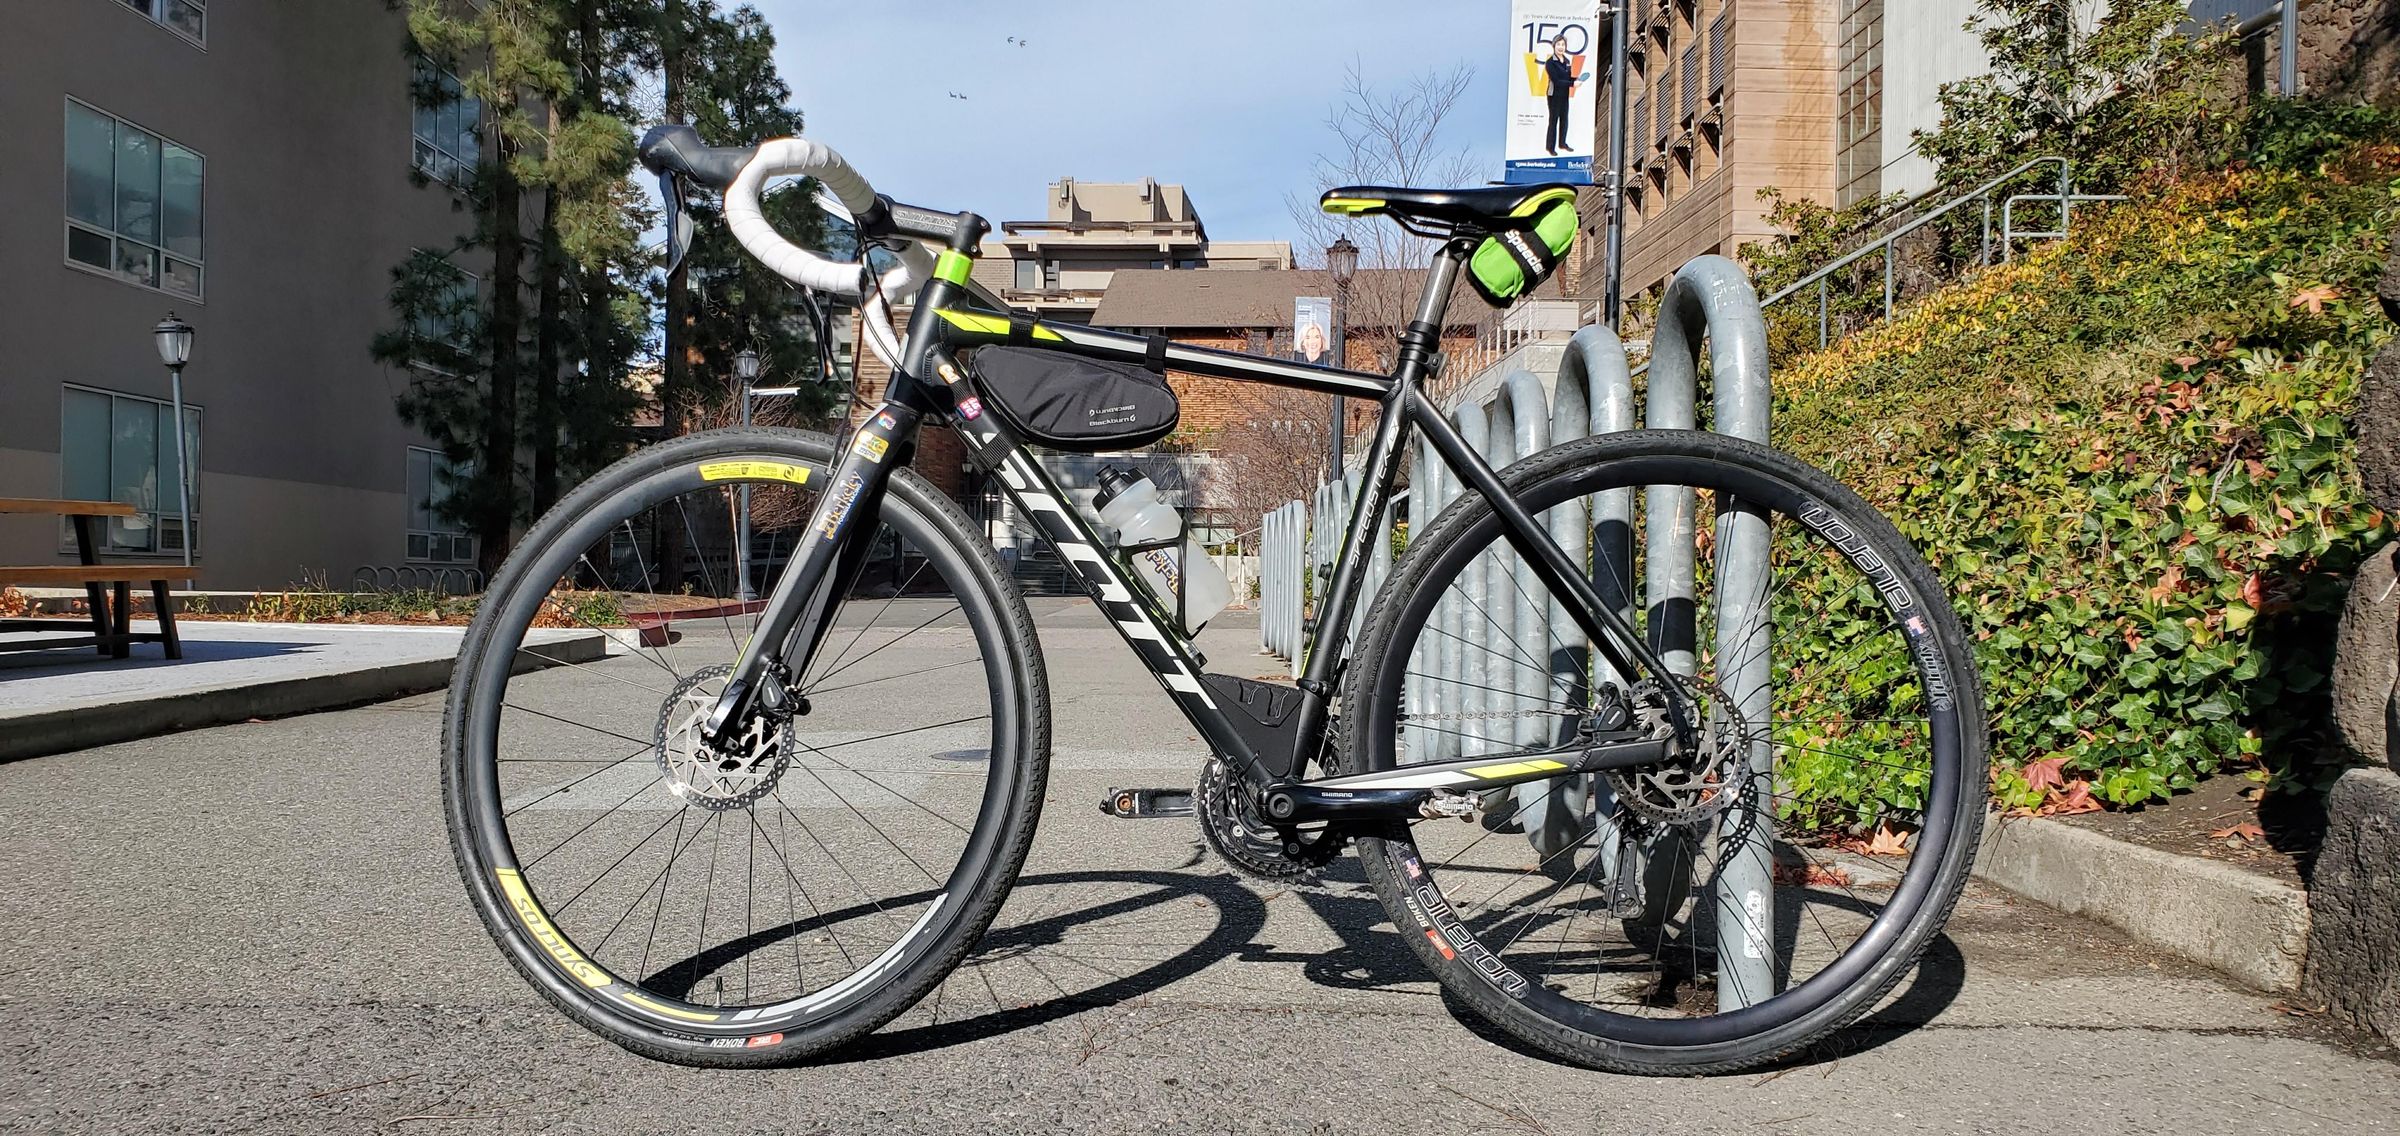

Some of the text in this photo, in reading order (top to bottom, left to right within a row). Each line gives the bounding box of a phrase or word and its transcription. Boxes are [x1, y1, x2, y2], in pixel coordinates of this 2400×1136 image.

[1522, 22, 1589, 65] 150
[1567, 161, 1589, 170] Berkeley
[1089, 417, 1130, 427] Blackburn
[818, 469, 864, 530] Berkeley
[1321, 791, 1353, 799] SHIMANO
[1403, 896, 1430, 928] BOKEN
[709, 1038, 747, 1048] BOKEN
